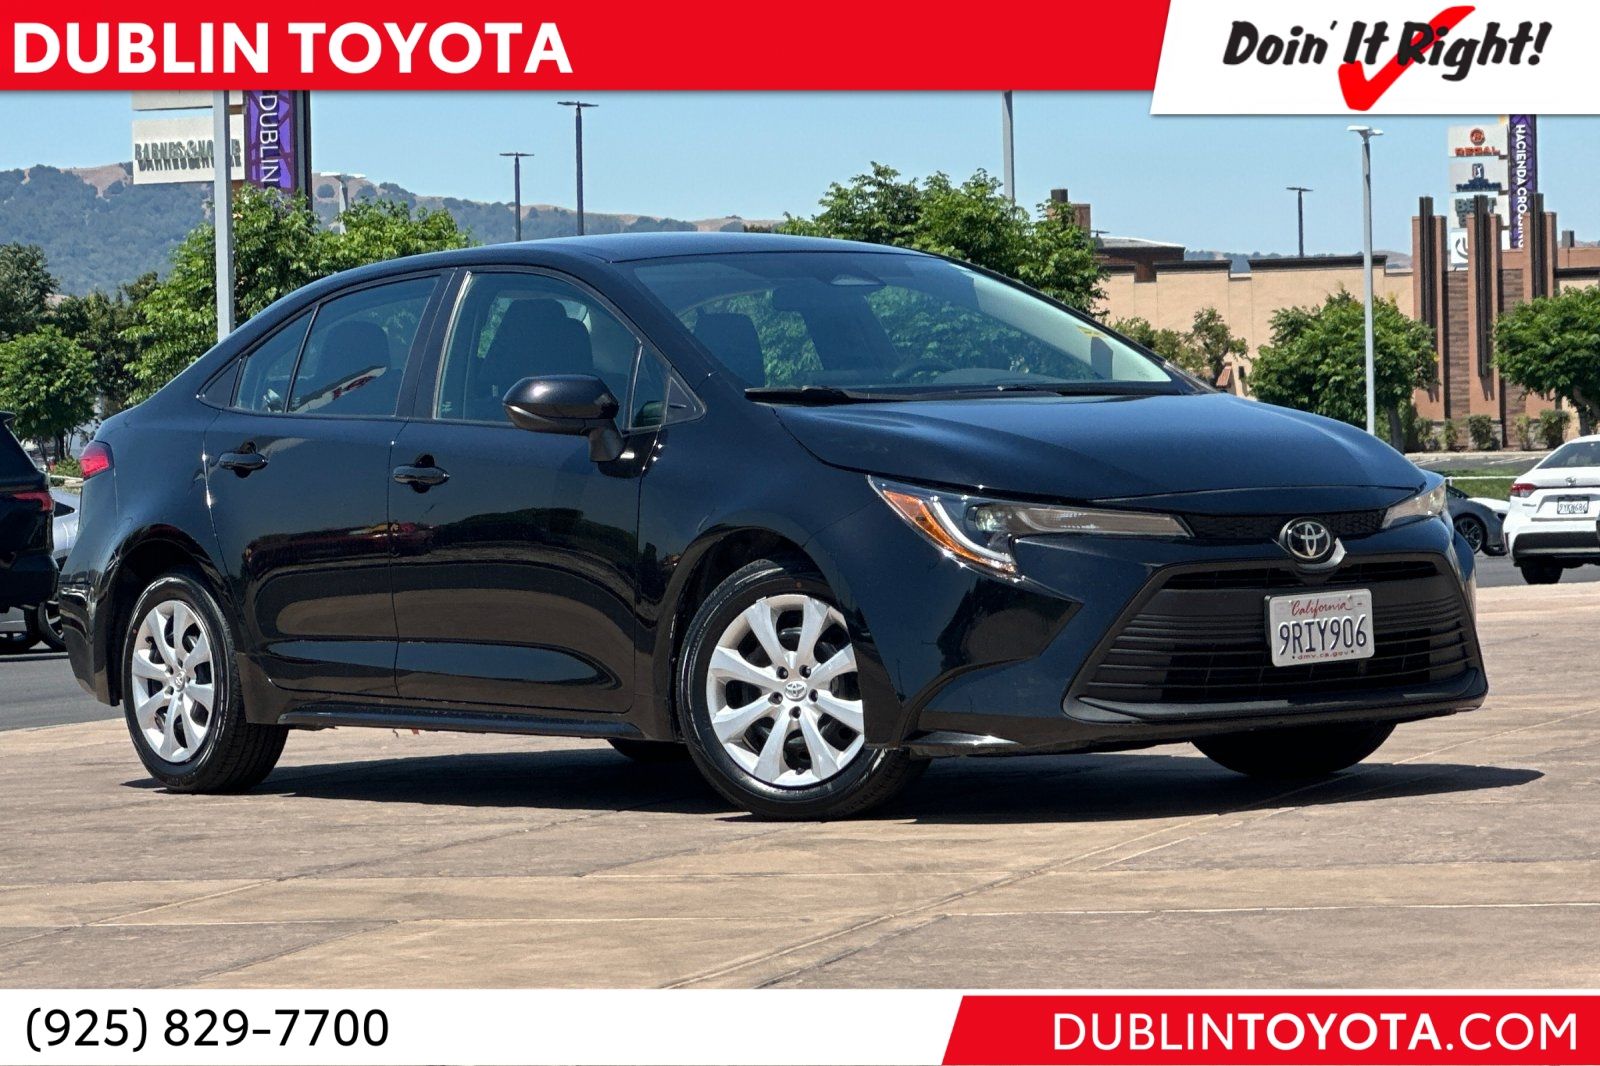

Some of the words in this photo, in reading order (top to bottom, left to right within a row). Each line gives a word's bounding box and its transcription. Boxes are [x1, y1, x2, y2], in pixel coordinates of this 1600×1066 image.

[134, 140, 185, 162] BARNES
[259, 94, 279, 183] DUBLIN
[1515, 124, 1527, 186] HACIENDA
[1455, 197, 1498, 215] BET
[1291, 599, 1352, 617] California
[1279, 615, 1367, 655] 9RIY906
